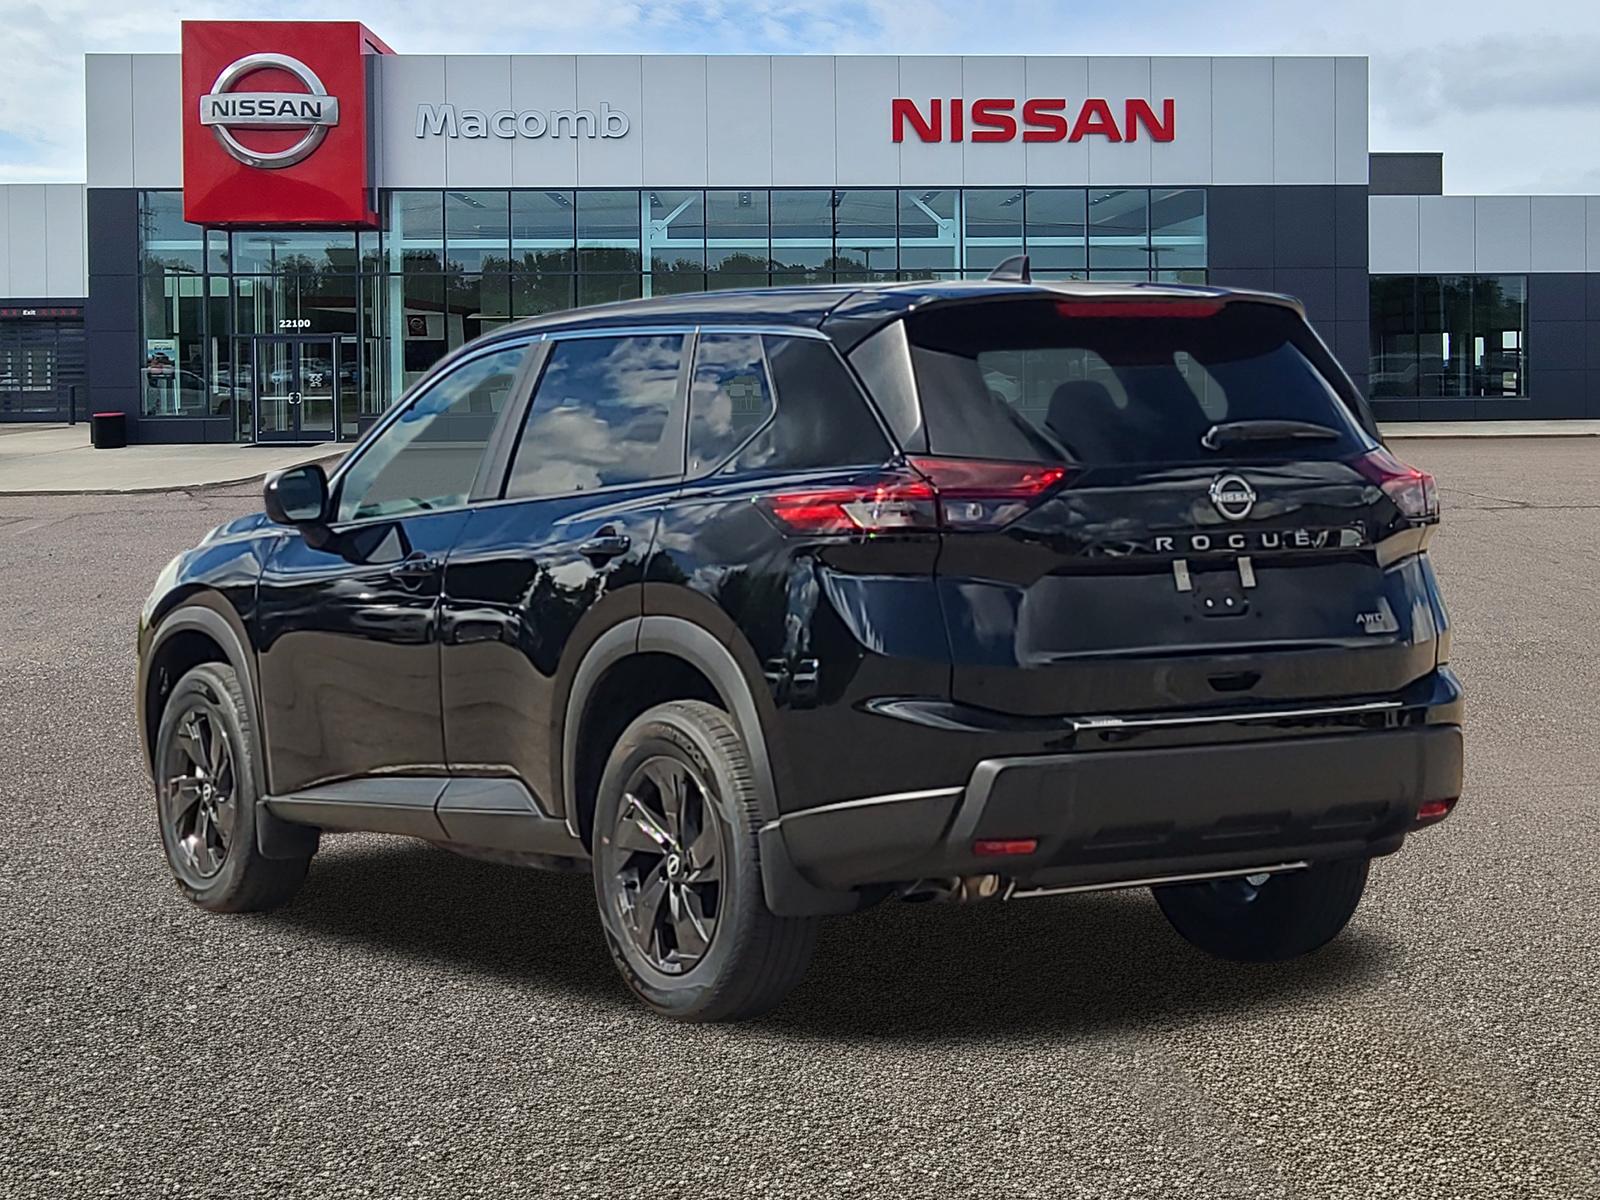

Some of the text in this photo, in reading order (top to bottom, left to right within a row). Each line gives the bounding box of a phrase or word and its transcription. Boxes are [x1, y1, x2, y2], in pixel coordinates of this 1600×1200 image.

[212, 100, 322, 117] NISSAN
[415, 102, 630, 139] Macomb
[892, 98, 1175, 143] NISSAN
[279, 319, 311, 328] 22100
[1155, 533, 1310, 550] ROGUE
